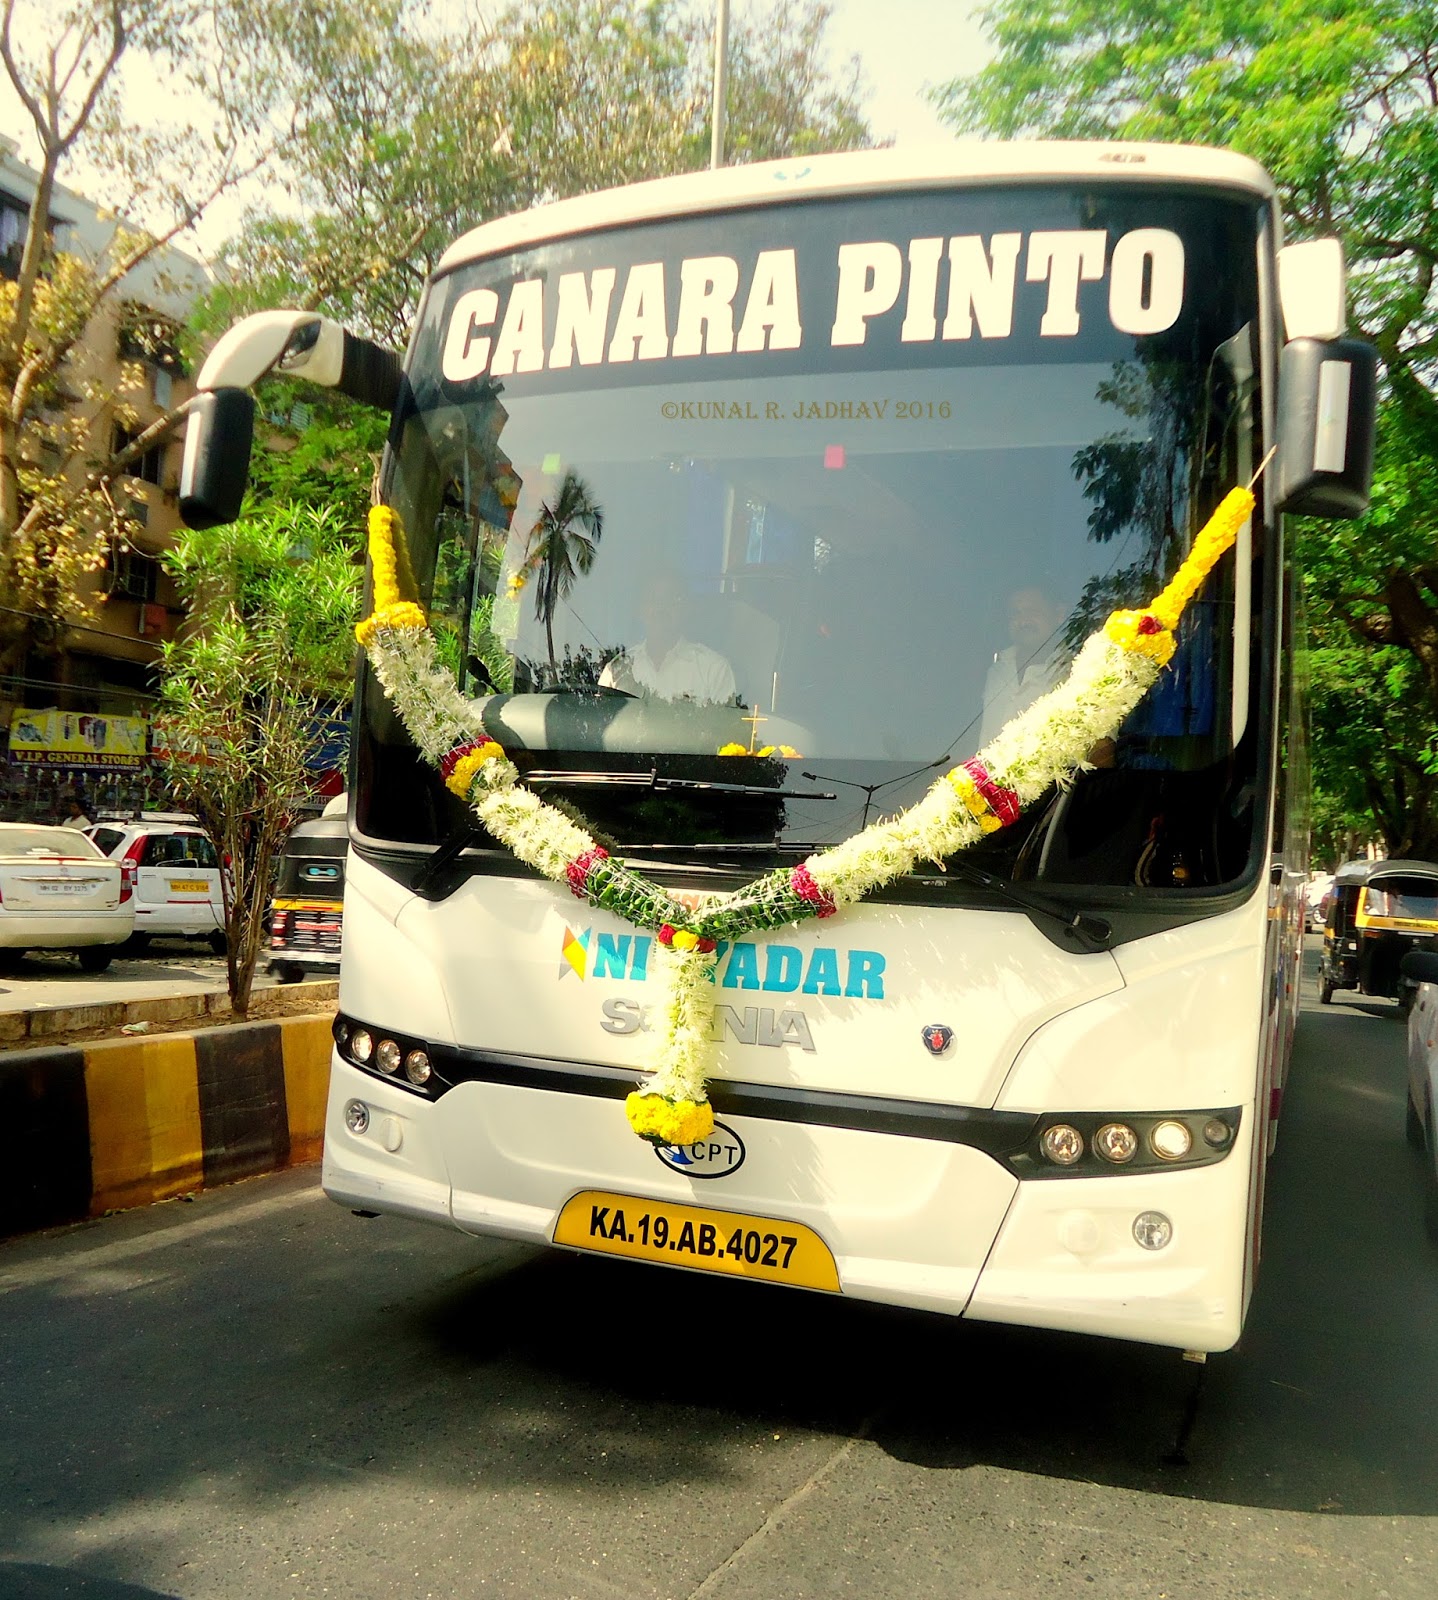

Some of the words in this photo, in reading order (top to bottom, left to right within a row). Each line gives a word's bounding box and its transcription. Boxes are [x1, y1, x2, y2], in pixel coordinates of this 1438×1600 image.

[442, 248, 802, 382] CANARA
[830, 227, 1185, 346] PINTO
[48, 752, 100, 764] GENERAL
[101, 755, 141, 766] STORES
[691, 1141, 738, 1165] CPT
[590, 1205, 798, 1270] KA.19.AB.4027
